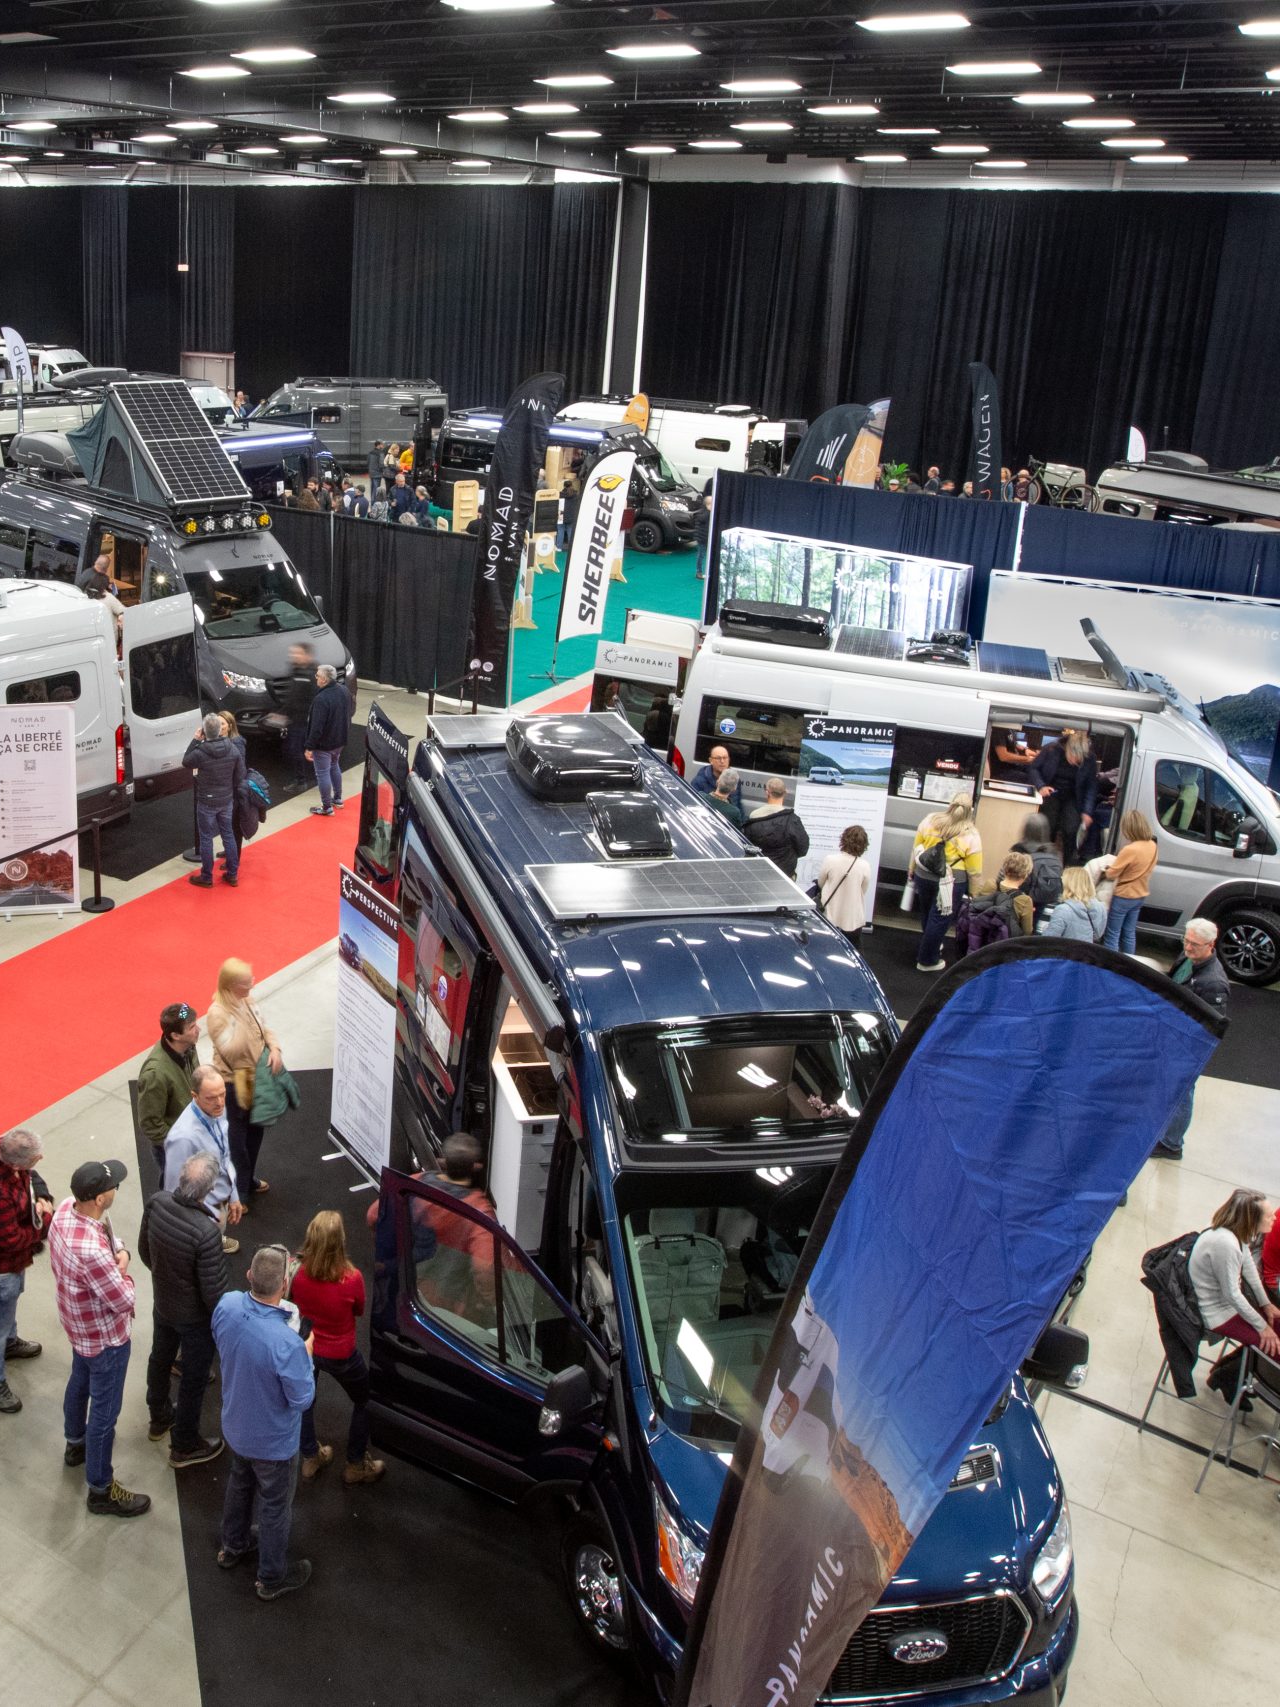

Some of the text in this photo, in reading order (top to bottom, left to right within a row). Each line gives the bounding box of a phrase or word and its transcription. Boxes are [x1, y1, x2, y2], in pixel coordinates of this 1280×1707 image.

[483, 486, 514, 581] NOMAD
[507, 522, 518, 549] VAN
[577, 493, 616, 625] SHERBEE
[623, 654, 674, 669] PANORAMIC
[10, 716, 46, 724] NOMAD
[14, 729, 63, 743] LIBERTÉ
[832, 725, 894, 737] PANORAMIC
[15, 743, 31, 753] SE
[33, 741, 64, 752] CRÉE
[76, 736, 103, 749] NOMAD
[376, 723, 408, 758] PERSPECTIVE
[936, 761, 960, 769] VENDU
[355, 889, 398, 931] PERSPECTIVE
[907, 1647, 937, 1660] Ford
